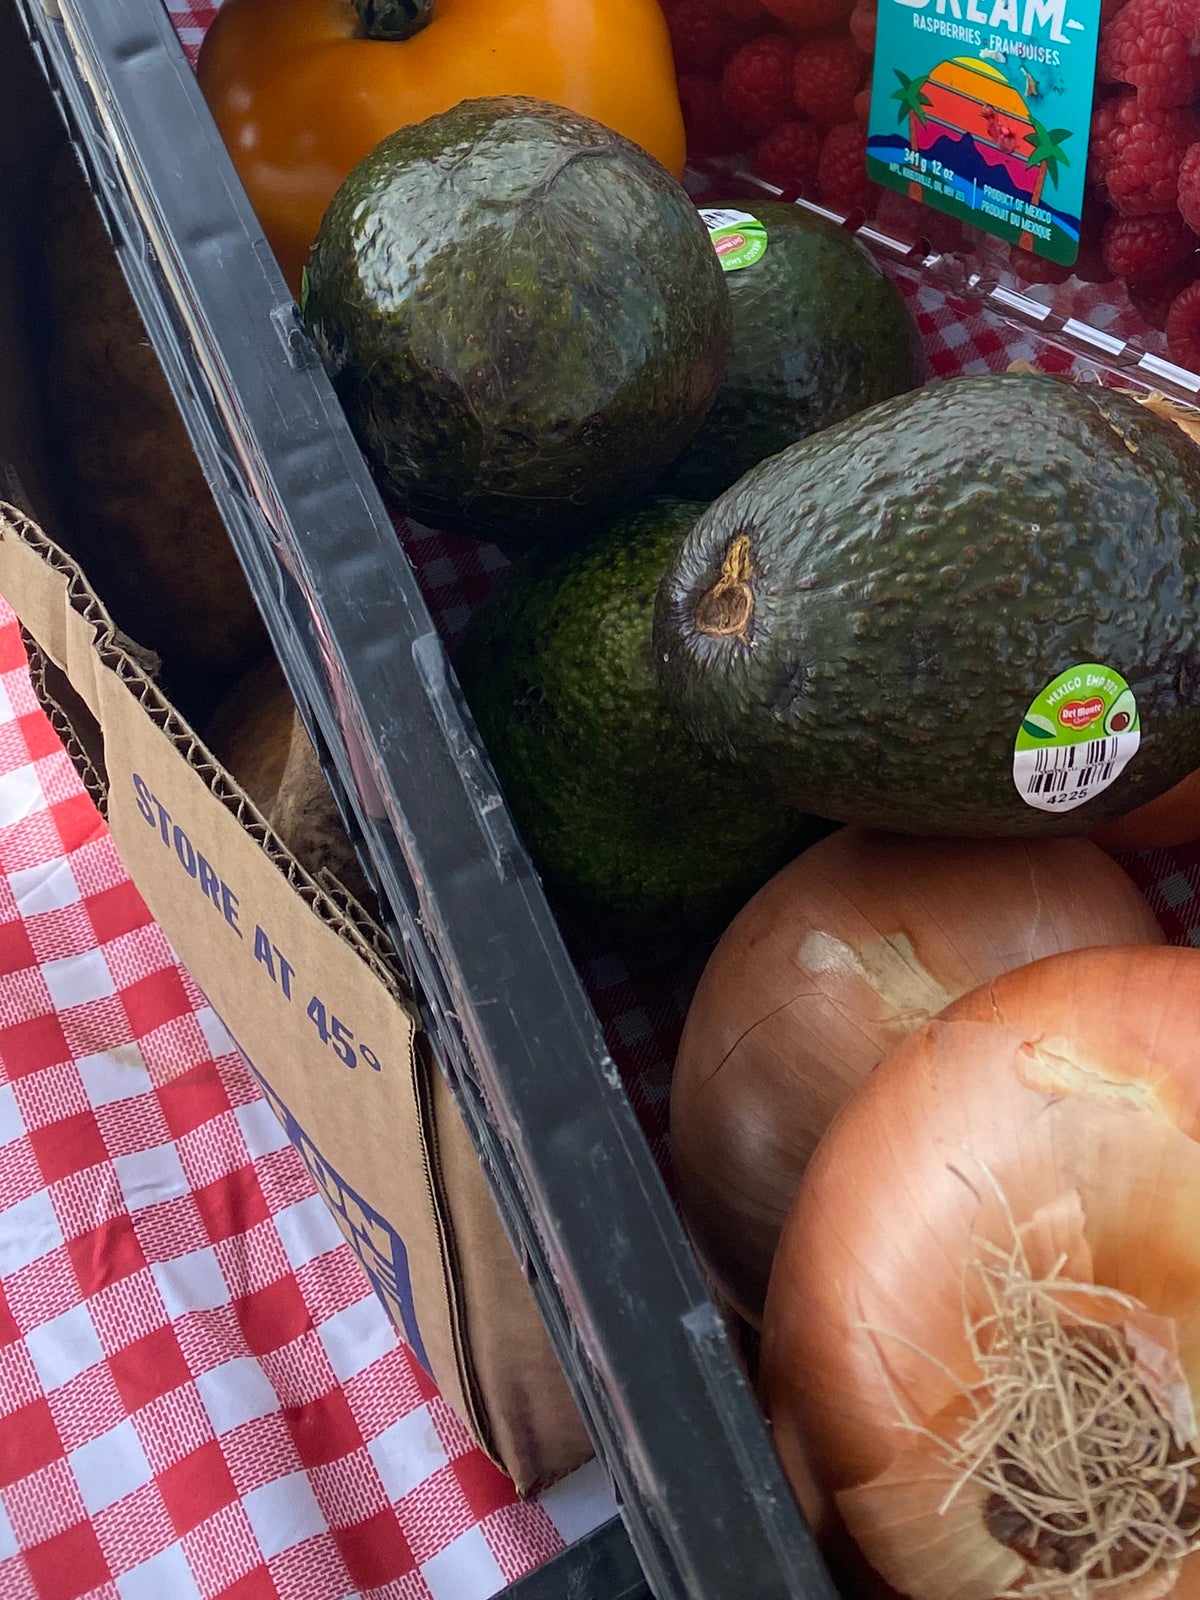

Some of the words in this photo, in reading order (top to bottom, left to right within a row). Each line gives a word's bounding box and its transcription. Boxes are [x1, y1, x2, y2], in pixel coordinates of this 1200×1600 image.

[913, 13, 981, 46] RASPBERRIES
[989, 34, 1061, 66] FRAMBOISES
[904, 147, 920, 167] 341
[920, 157, 927, 173] g
[932, 160, 942, 176] 12
[943, 168, 954, 181] oz
[981, 199, 1010, 222] PRODUIT
[1010, 212, 1021, 227] DU
[1021, 217, 1052, 241] MEXIQUE
[984, 184, 1014, 208] PRODUCT
[1015, 198, 1024, 212] OF
[1025, 203, 1052, 225] MEXICO
[1046, 676, 1082, 706] MEXICO
[1086, 673, 1106, 688] EMP
[1062, 708, 1077, 719] Del
[1077, 703, 1102, 717] Monte
[1046, 788, 1089, 805] 4225
[132, 773, 243, 939] STORE
[254, 924, 296, 1001] AT
